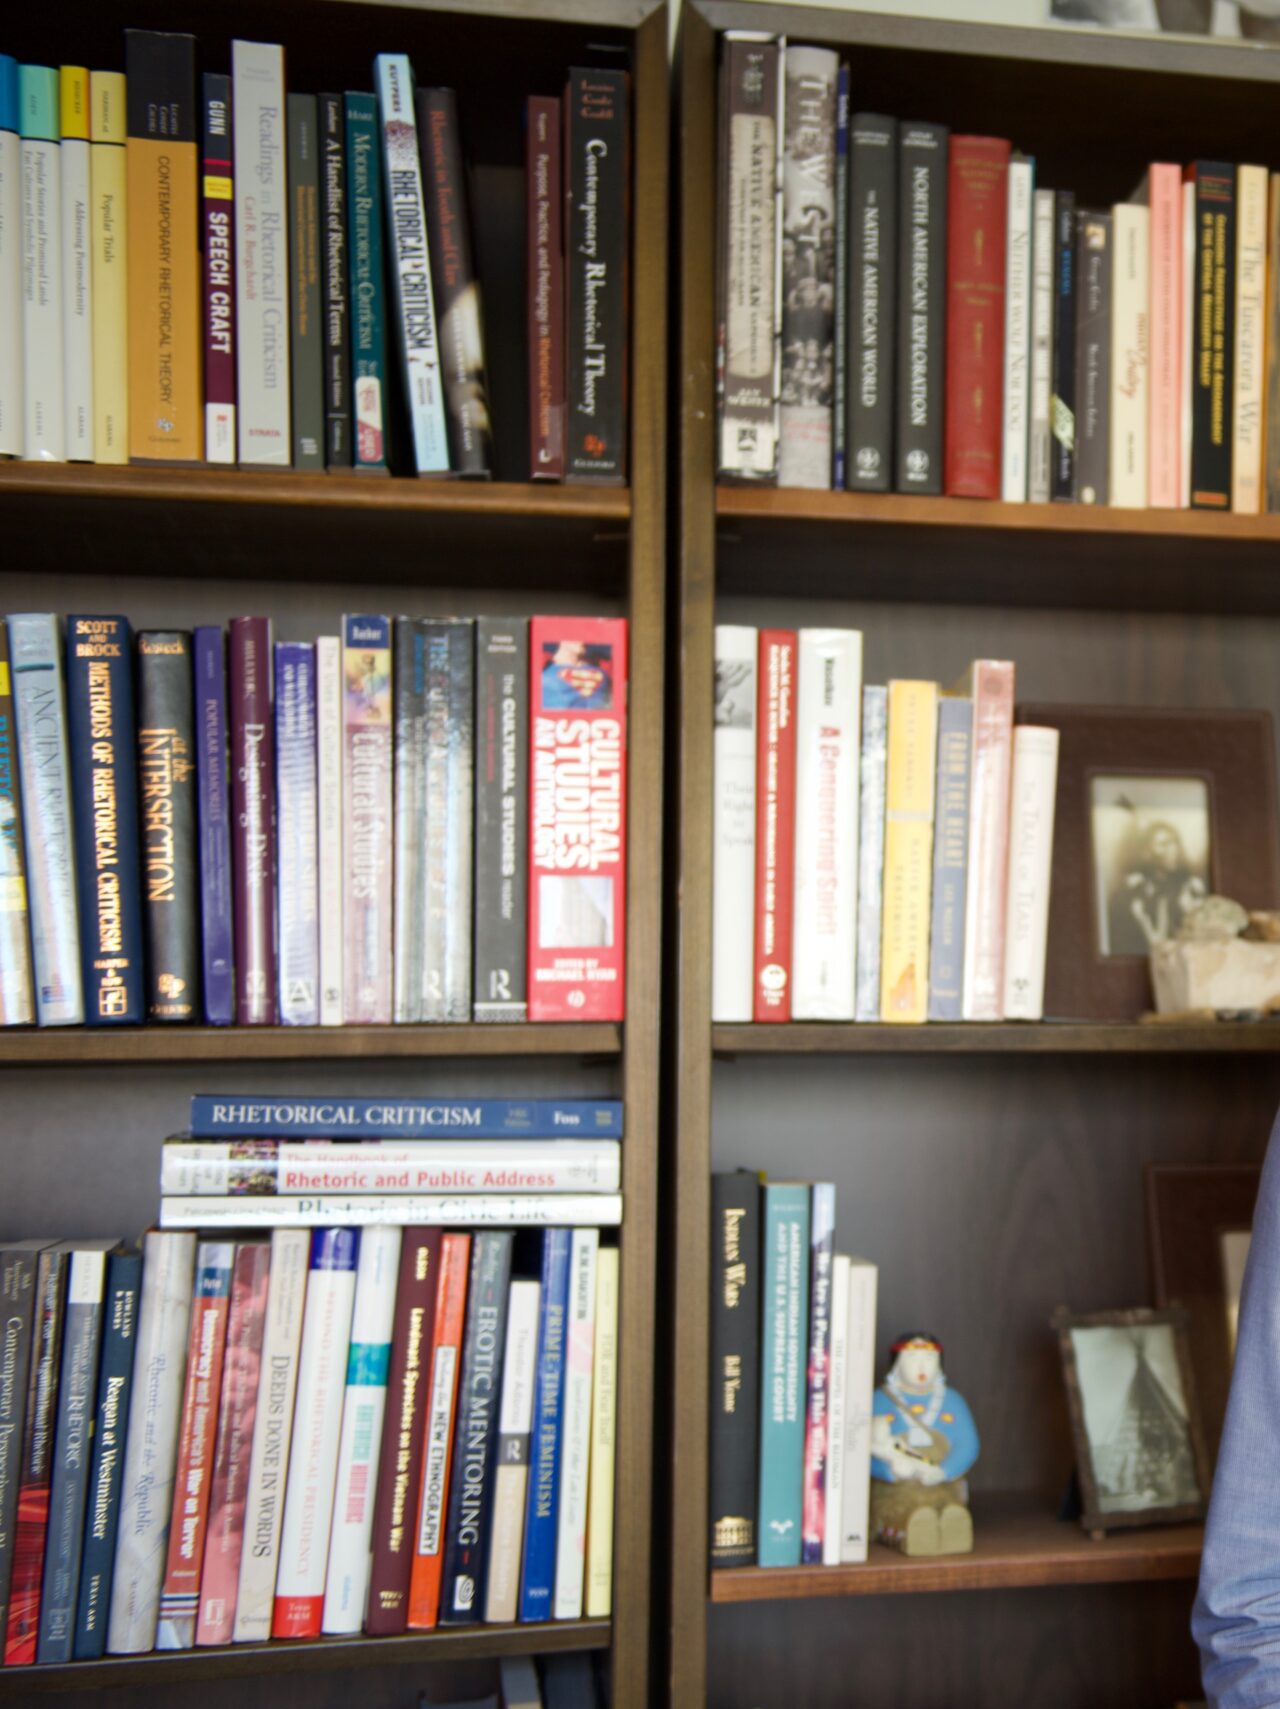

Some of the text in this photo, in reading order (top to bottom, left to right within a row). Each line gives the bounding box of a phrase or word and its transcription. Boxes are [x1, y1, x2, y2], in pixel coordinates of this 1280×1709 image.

[208, 99, 227, 135] GUNN
[388, 64, 402, 113] KUYPERS
[255, 106, 279, 185] Readings
[353, 132, 371, 194] MODERN
[798, 74, 829, 249] THE WEST
[101, 194, 114, 263] Popular Trials
[243, 196, 257, 221] Carl
[244, 224, 256, 236] R.
[355, 196, 374, 279] RHETORICAL
[429, 110, 461, 287] Rhetoric in Tooth and Claw
[73, 201, 88, 317] Addressing Postmodernity
[157, 156, 173, 404] CONTEMPORARY RHETORICAL THEORY
[208, 212, 231, 354] SPEECH CRAFT
[260, 211, 282, 302] Rhetorical
[327, 139, 344, 346] A Handlist of Rhetorical Terms
[391, 170, 434, 350] RHETORICAL CRITICISM
[538, 246, 550, 269] and
[577, 138, 608, 417] Contemporary Rhetorical Theory
[358, 281, 377, 350] CRITICISM
[539, 325, 551, 337] in
[910, 166, 930, 425] NORTH AMERICAN EXPLORATION
[262, 308, 285, 390] Criticism
[1237, 241, 1264, 445] The Tuscarora War
[75, 620, 119, 634] SCOTT
[75, 643, 122, 657] BROCK
[171, 736, 195, 783] at the
[205, 699, 218, 755] POPULAR
[819, 726, 842, 740] A
[87, 661, 123, 953] METHODS OF RHETORICAL CRITICISM
[138, 727, 178, 902] INTERSECTION
[238, 722, 267, 829] Designing
[352, 732, 386, 900] Cultural Studies
[501, 673, 516, 920] the CULTURAL STUDIES reader
[534, 716, 556, 870] AN ANTHOLOGY
[555, 718, 591, 870] STUDIES
[590, 718, 621, 871] CULTURAL
[943, 731, 968, 868] FROM THE HEART
[211, 1104, 482, 1126] RHETORICAL CRITICISM
[553, 1111, 580, 1125] Foss
[285, 1170, 555, 1188] Rhetoric and Public Address
[723, 1208, 747, 1309] INDIAN WARS
[121, 1290, 134, 1339] ROWLAND
[771, 1221, 788, 1424] AND THE U.S. SUPREME COURT
[785, 1221, 801, 1423] AMERICAN INDIAN SOVEREIGNTY
[812, 1319, 829, 1371] People
[269, 1355, 292, 1415] DEEDS
[600, 1364, 613, 1385] and
[722, 1354, 742, 1377] Bill
[812, 1371, 826, 1389] in
[64, 1394, 87, 1469] RHETORIC
[133, 1352, 167, 1537] Rhetoric and the Republic
[179, 1308, 219, 1560] Democracy and America's War on Terror
[263, 1419, 284, 1468] DONE
[307, 1387, 328, 1480] RHETORICAL
[389, 1307, 426, 1553] Landmark Speeches on the Vietnam War
[458, 1305, 500, 1546] EROTIC MENTORING
[535, 1304, 564, 1518] PRIME-TIME FEMINISM
[810, 1391, 825, 1424] This
[91, 1376, 126, 1540] Reagan at Westminster
[260, 1471, 278, 1491] IN
[809, 1425, 825, 1473] World
[251, 1495, 276, 1559] WORDS
[296, 1485, 318, 1577] PRESIDENCY
[88, 1574, 101, 1606] TEXAS
